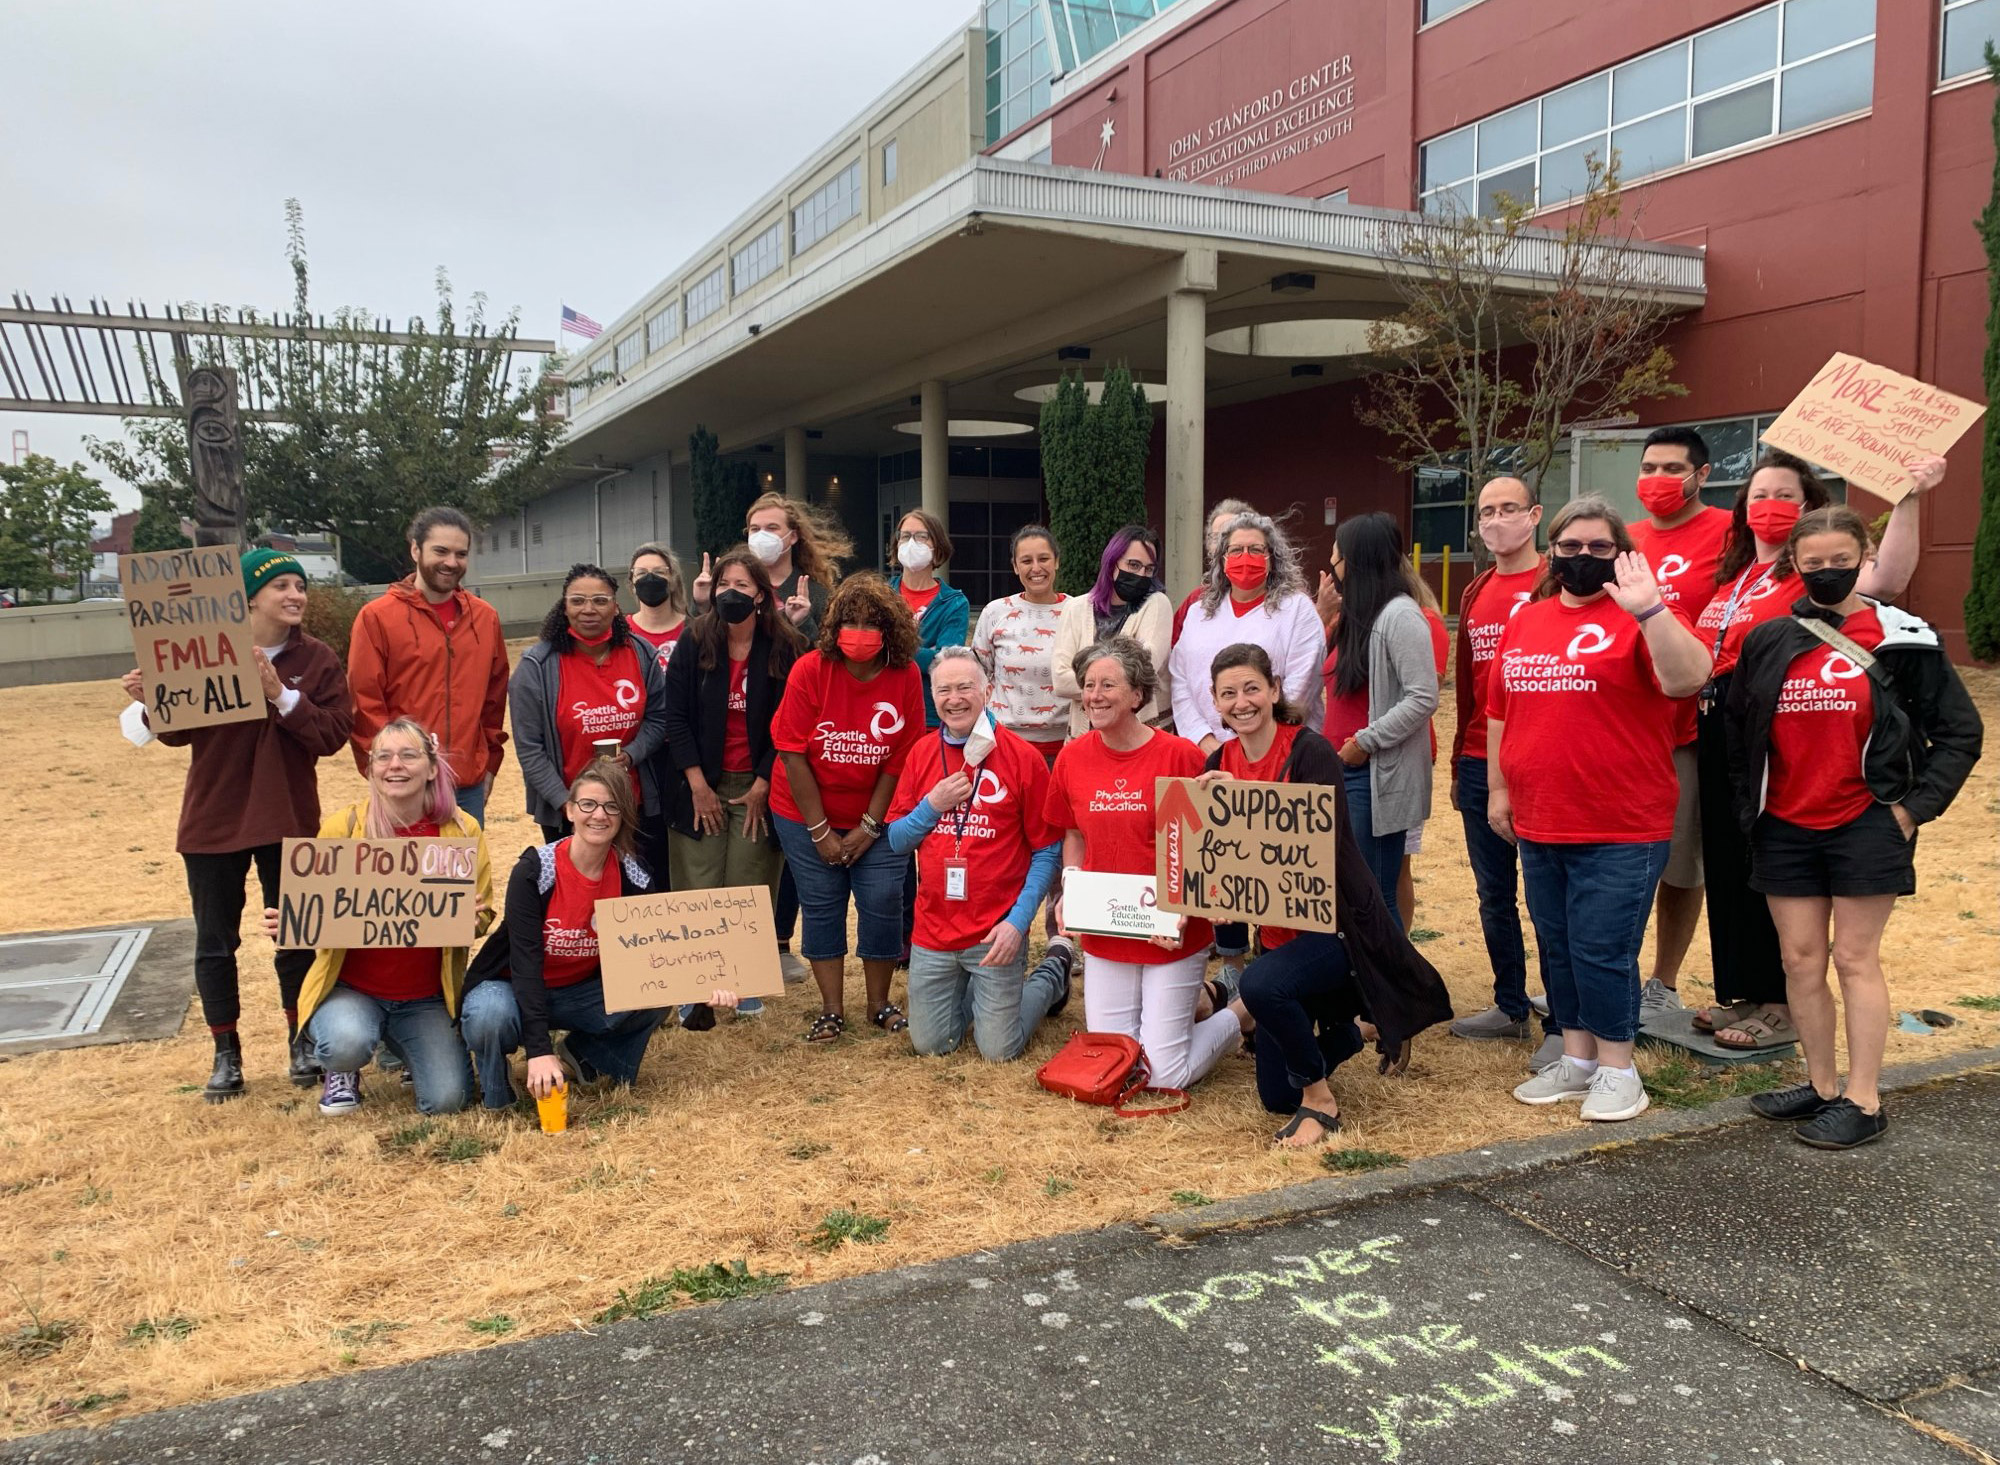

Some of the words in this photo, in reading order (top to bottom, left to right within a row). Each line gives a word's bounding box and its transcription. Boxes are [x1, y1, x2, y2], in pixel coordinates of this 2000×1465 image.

[1169, 128, 1201, 163] JOHN
[1208, 88, 1283, 141] STANFORD
[1289, 54, 1353, 101] CENTER
[1168, 165, 1188, 182] FOR
[1191, 122, 1271, 176] EDUCATIONAL
[1275, 85, 1355, 136] EXCELLENCE
[1237, 154, 1269, 180] THIRD
[1271, 136, 1311, 165] AVENUE
[1313, 117, 1353, 145] SOUTH
[1812, 362, 1899, 413] MORE
[1796, 404, 1825, 425] WE
[1822, 416, 1848, 437] ARE
[1887, 401, 1953, 430] SUPPORT
[1883, 415, 1936, 441] STAFF
[1772, 425, 1817, 452] SEND
[1852, 460, 1905, 491] HELP!
[131, 551, 234, 584] ADOPTION
[153, 632, 238, 673] FMLA
[1501, 648, 1560, 669] Seattle
[1503, 663, 1586, 679] Education
[1505, 677, 1597, 693] Association
[1782, 677, 1816, 690] attle
[154, 683, 199, 724] for
[203, 674, 251, 714] ALL
[1779, 687, 1846, 702] ucation
[572, 701, 617, 719] Seattle
[1776, 699, 1857, 714] ssociation
[582, 711, 636, 726] Education
[814, 721, 867, 742] Seattle
[820, 750, 892, 765] Associati
[822, 740, 890, 755] Education
[1095, 788, 1142, 803] Physical
[1089, 801, 1147, 813] Education
[932, 824, 996, 839] socation
[290, 841, 344, 878] Our
[400, 840, 419, 877] IS
[1198, 829, 1250, 874] for
[1260, 841, 1318, 868] our
[1183, 867, 1211, 909] ML
[1215, 874, 1270, 916] SPED
[1278, 870, 1333, 897] STUD-
[612, 888, 758, 926] Unacknowledged
[1107, 898, 1139, 913] Seattle
[1111, 910, 1151, 921] Education
[1285, 899, 1333, 926] ENTS
[279, 891, 324, 947] NO
[333, 887, 466, 919] BLACKOUT
[743, 920, 758, 935] is
[1110, 918, 1156, 930] Association
[363, 919, 420, 947] DAYS
[543, 918, 588, 939] Seatte
[544, 945, 600, 957] Associati
[546, 935, 599, 948] Educatio
[649, 949, 727, 969] burning
[639, 979, 669, 994] me
